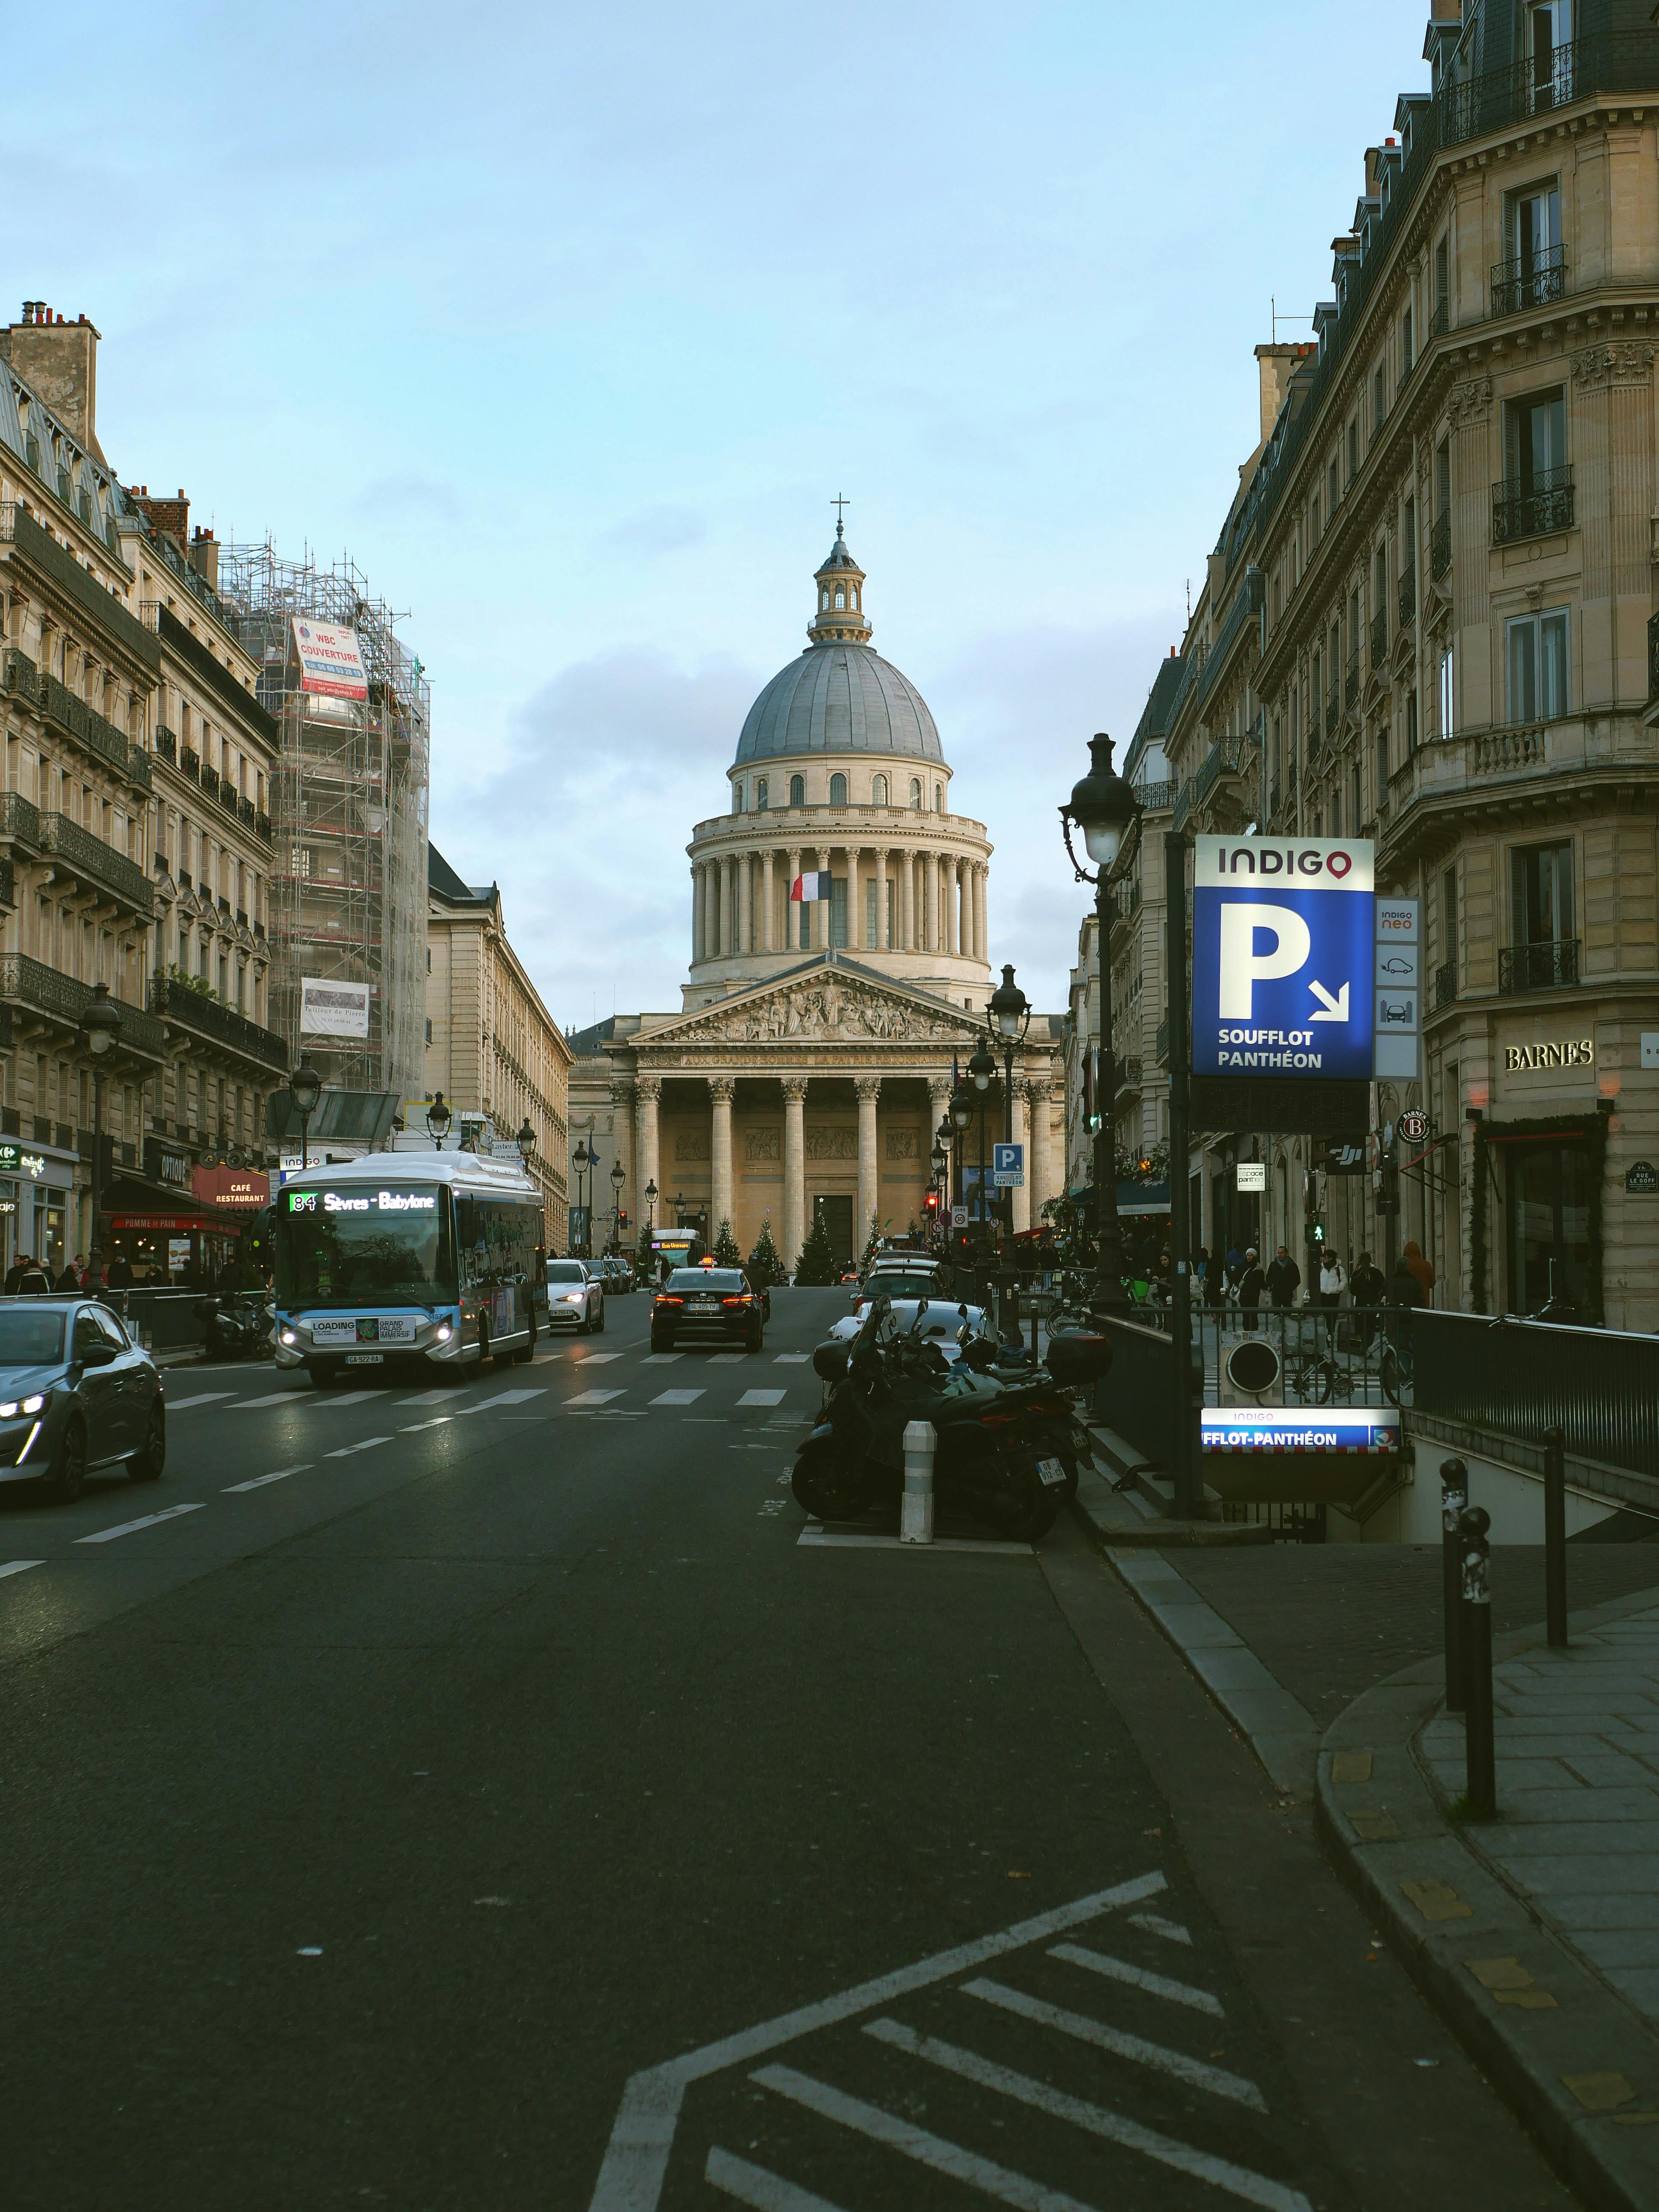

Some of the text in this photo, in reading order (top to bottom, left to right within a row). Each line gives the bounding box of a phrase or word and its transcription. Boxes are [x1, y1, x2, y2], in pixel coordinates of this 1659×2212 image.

[316, 634, 335, 645] WBC
[301, 645, 359, 663] COUVERTURE
[1219, 848, 1352, 880] INDIGO
[1382, 919, 1412, 929] neo
[1219, 903, 1311, 1019] P
[305, 1006, 332, 1014] Tailleur
[1219, 1029, 1314, 1046] SOUFFLOT
[685, 1055, 710, 1064] AUX
[711, 1055, 758, 1064] GRANDS
[760, 1055, 809, 1064] HOMMES
[815, 1055, 830, 1064] LA
[830, 1055, 872, 1064] PATRIE
[1218, 1050, 1321, 1068] PANTHÉON
[1504, 1041, 1591, 1070] BARNES
[1403, 1111, 1427, 1120] BARNES
[1400, 1127, 1422, 1142] INTERNATIONAL
[1409, 1119, 1421, 1135] B
[286, 1158, 320, 1166] INDGO
[1002, 1150, 1015, 1167] P
[162, 1155, 186, 1182] OPTIQUE
[231, 1183, 251, 1192] CAFÉ
[294, 1196, 316, 1211] 84
[324, 1193, 369, 1211] Sèvres
[378, 1191, 435, 1211] Babylone
[125, 1219, 151, 1227] POMME
[160, 1219, 175, 1228] PAIN
[313, 1322, 355, 1330] LOADING
[1234, 1413, 1273, 1421] INDIGO
[1202, 1431, 1337, 1446] FFLOT-PANTHÉON
